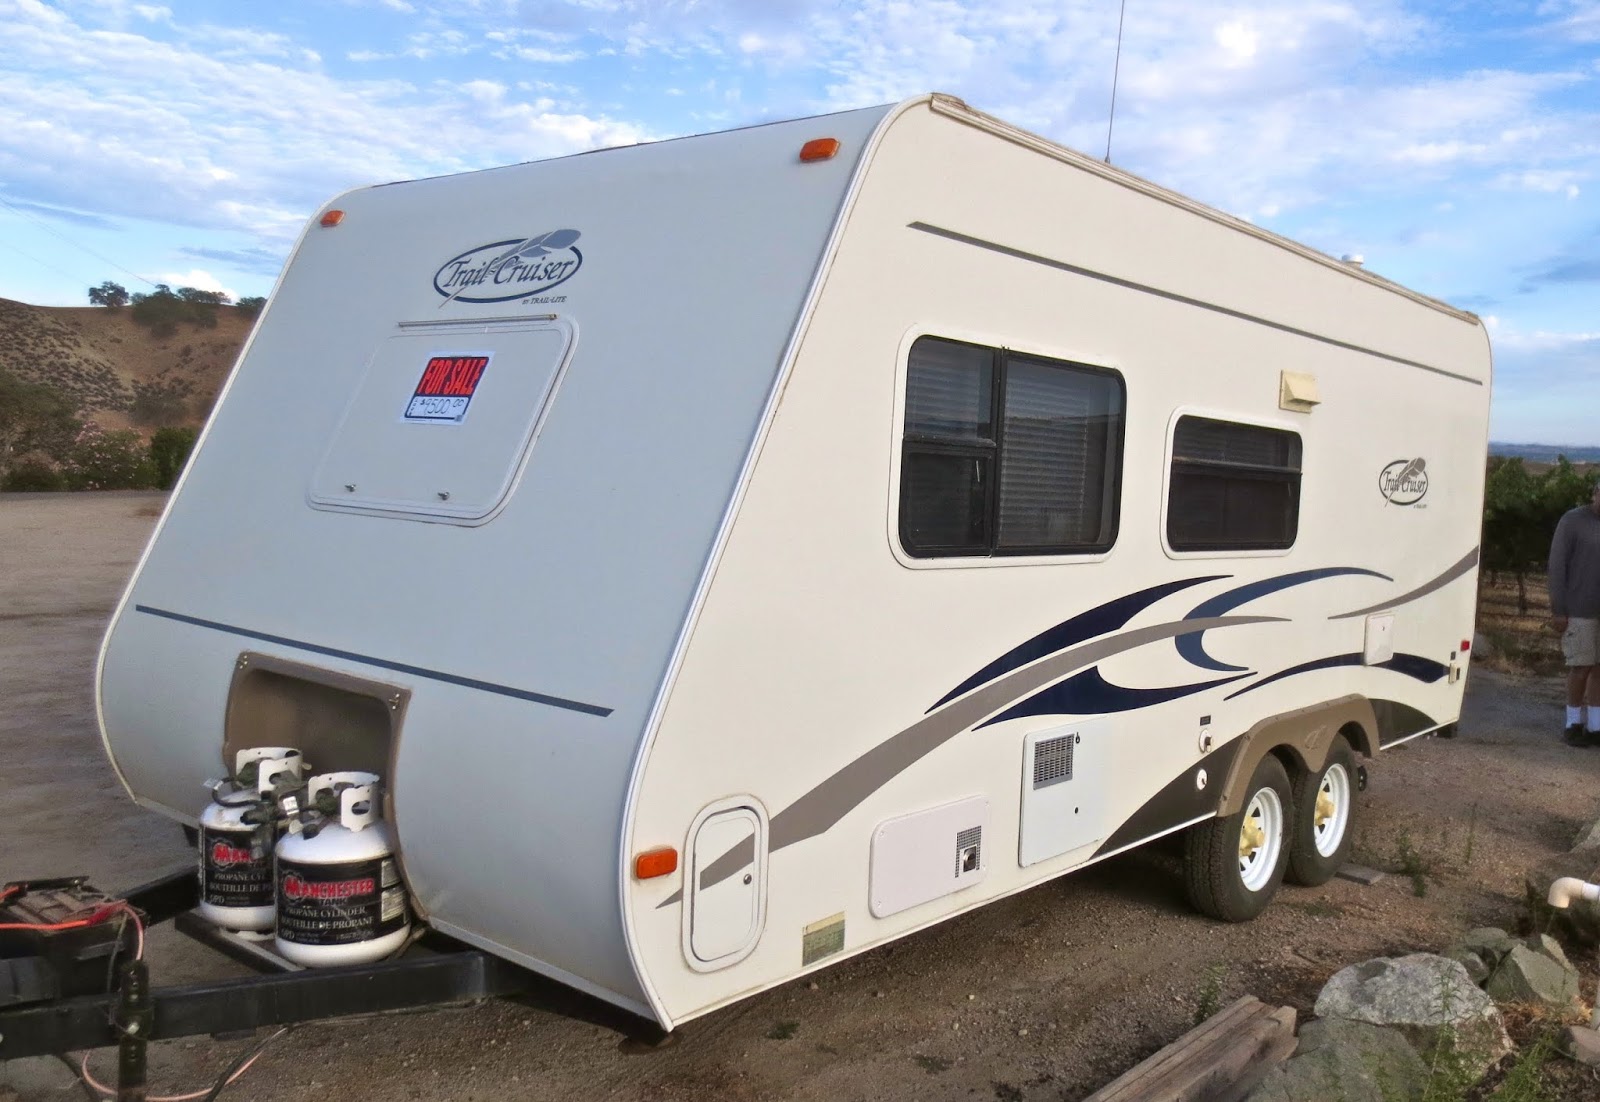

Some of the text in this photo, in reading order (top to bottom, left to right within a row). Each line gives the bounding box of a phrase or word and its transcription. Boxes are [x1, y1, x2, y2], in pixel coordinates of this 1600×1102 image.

[443, 255, 575, 287] Trail Cruiser
[417, 358, 487, 395] FOR SALE
